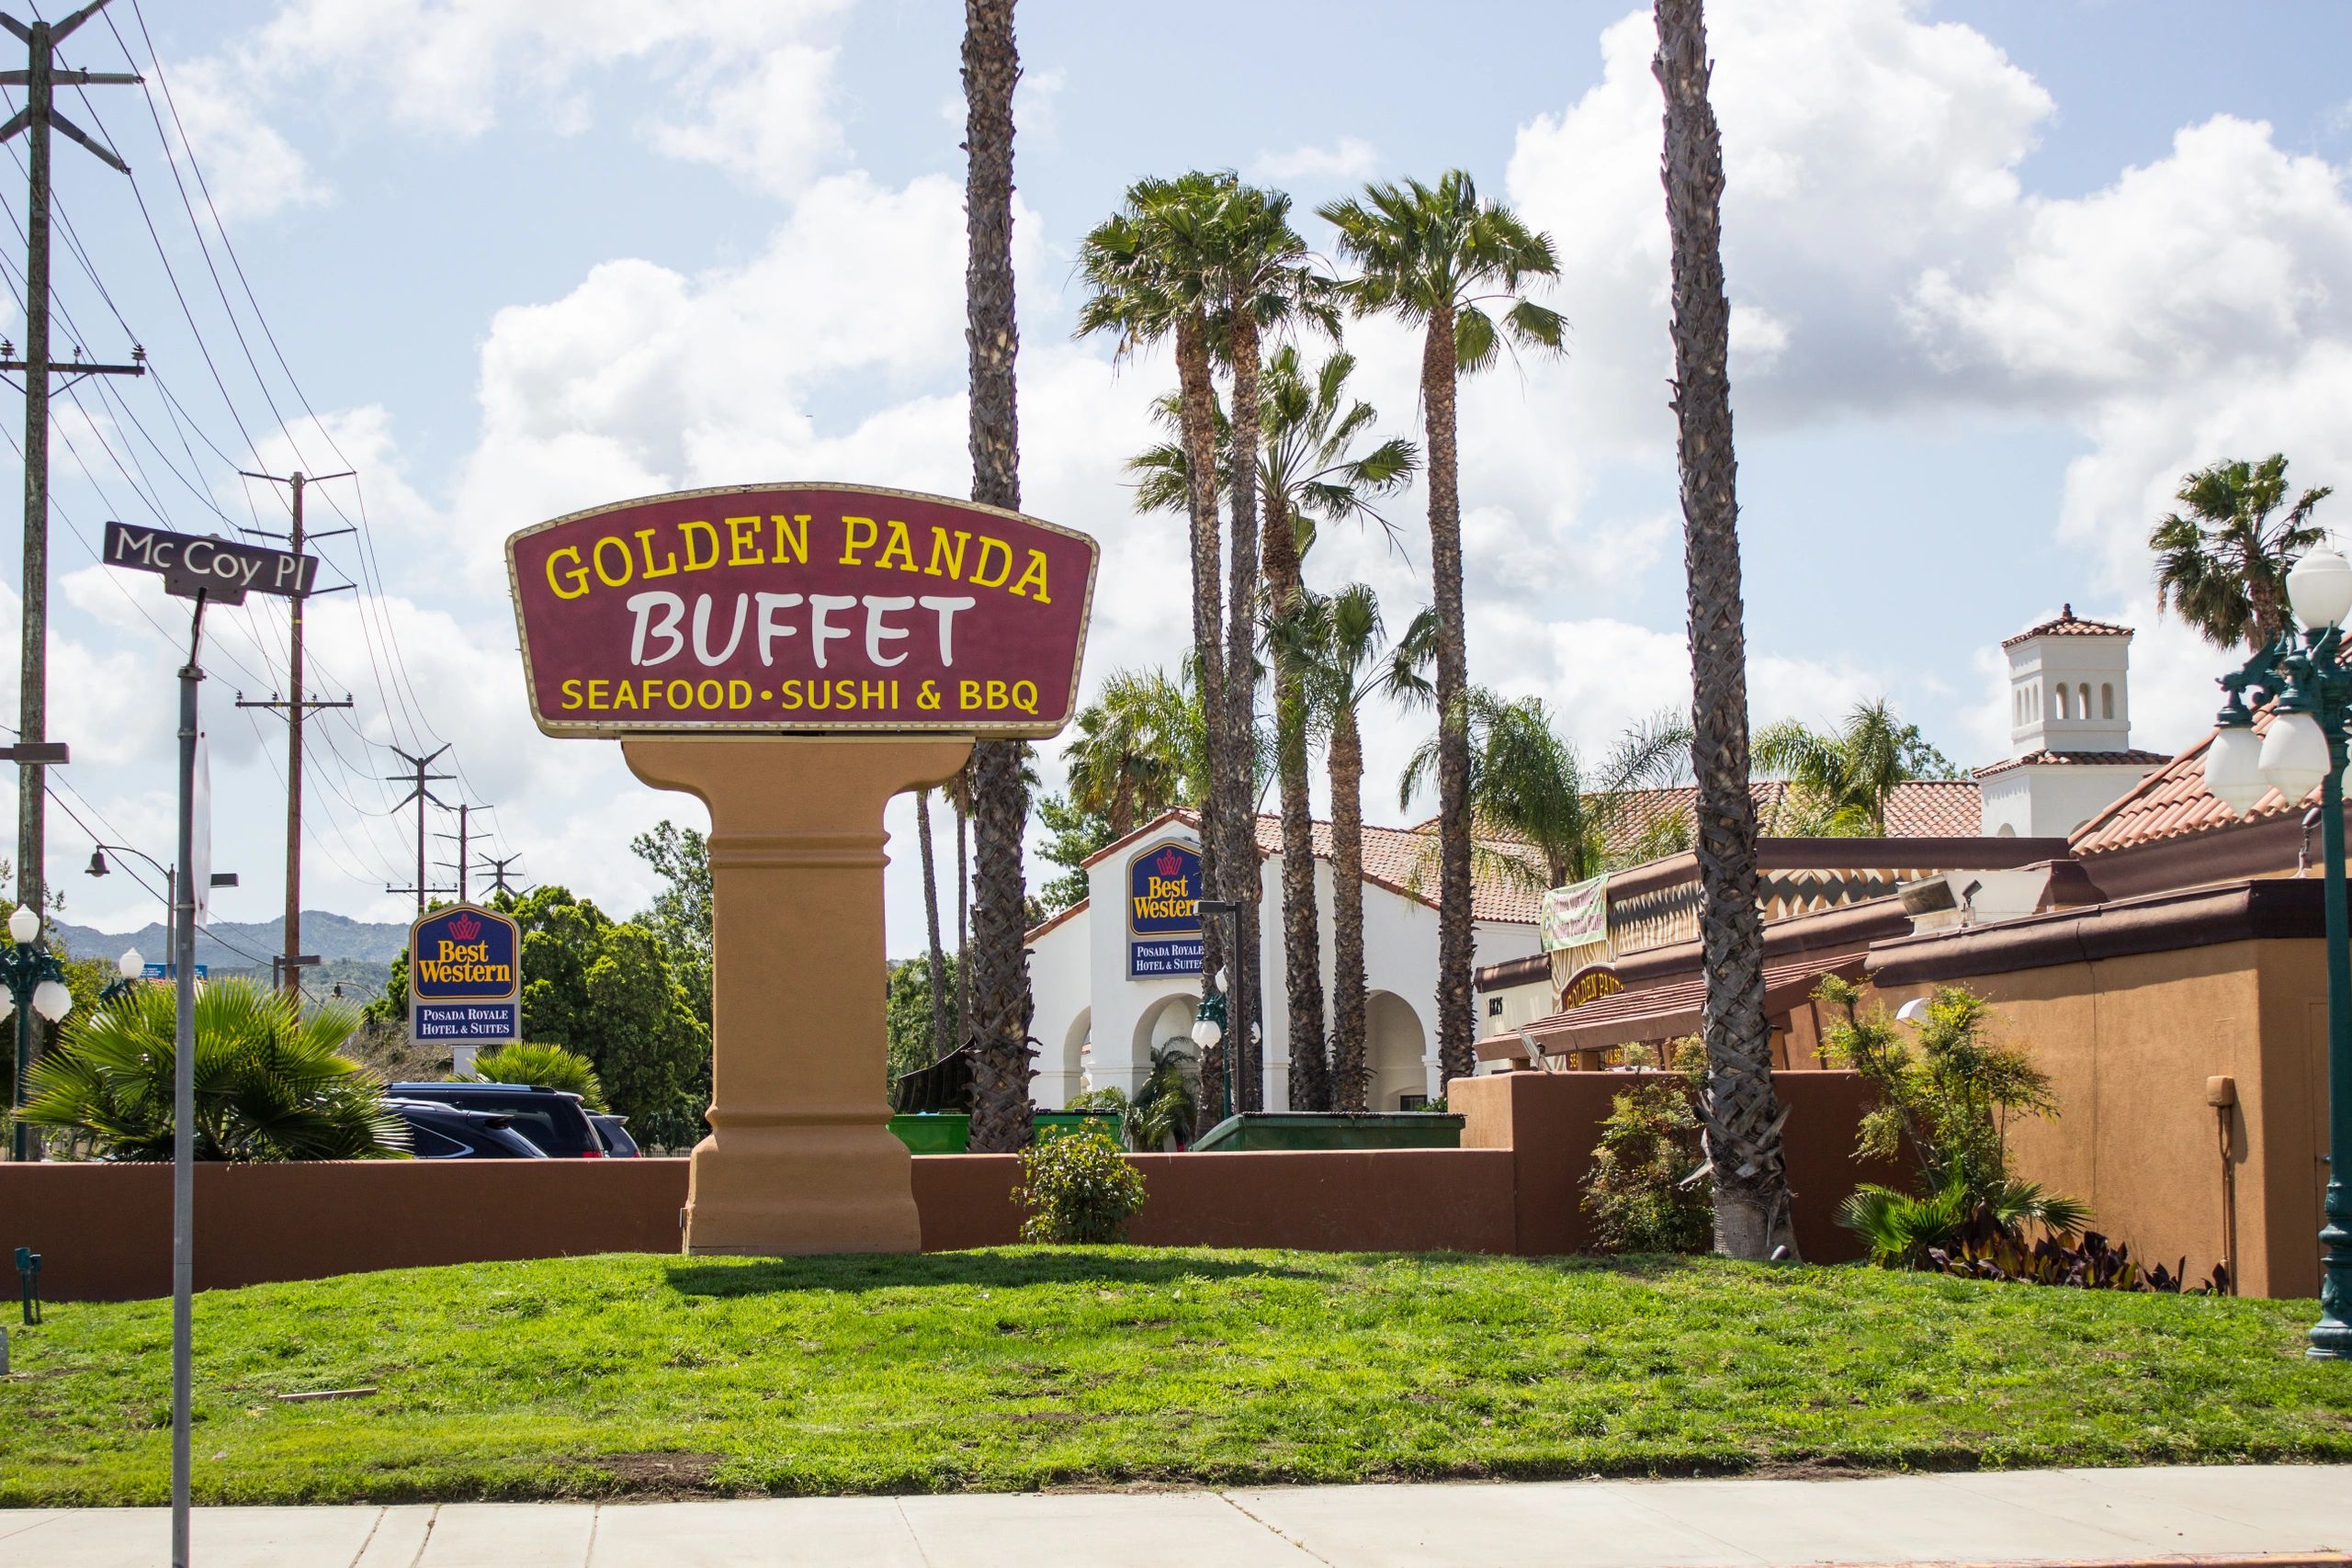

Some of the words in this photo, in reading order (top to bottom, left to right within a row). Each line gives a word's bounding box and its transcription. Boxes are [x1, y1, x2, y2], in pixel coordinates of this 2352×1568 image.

[116, 527, 175, 568] Mc
[184, 541, 263, 586] Coy
[275, 554, 306, 591] Pl
[546, 514, 812, 600] GOLDEN
[838, 515, 1052, 604] PANDA
[627, 591, 976, 669] BUFFET
[561, 678, 752, 710] SEAFOOD
[782, 678, 899, 710] SUSHI
[915, 680, 942, 710] &
[959, 679, 1039, 716] BBQ
[1148, 874, 1189, 899] Best
[437, 940, 489, 963] Best
[1165, 962, 1172, 970] &
[419, 960, 511, 983] Western
[1566, 973, 1597, 1009] GOLDEN
[460, 1026, 468, 1034] &
